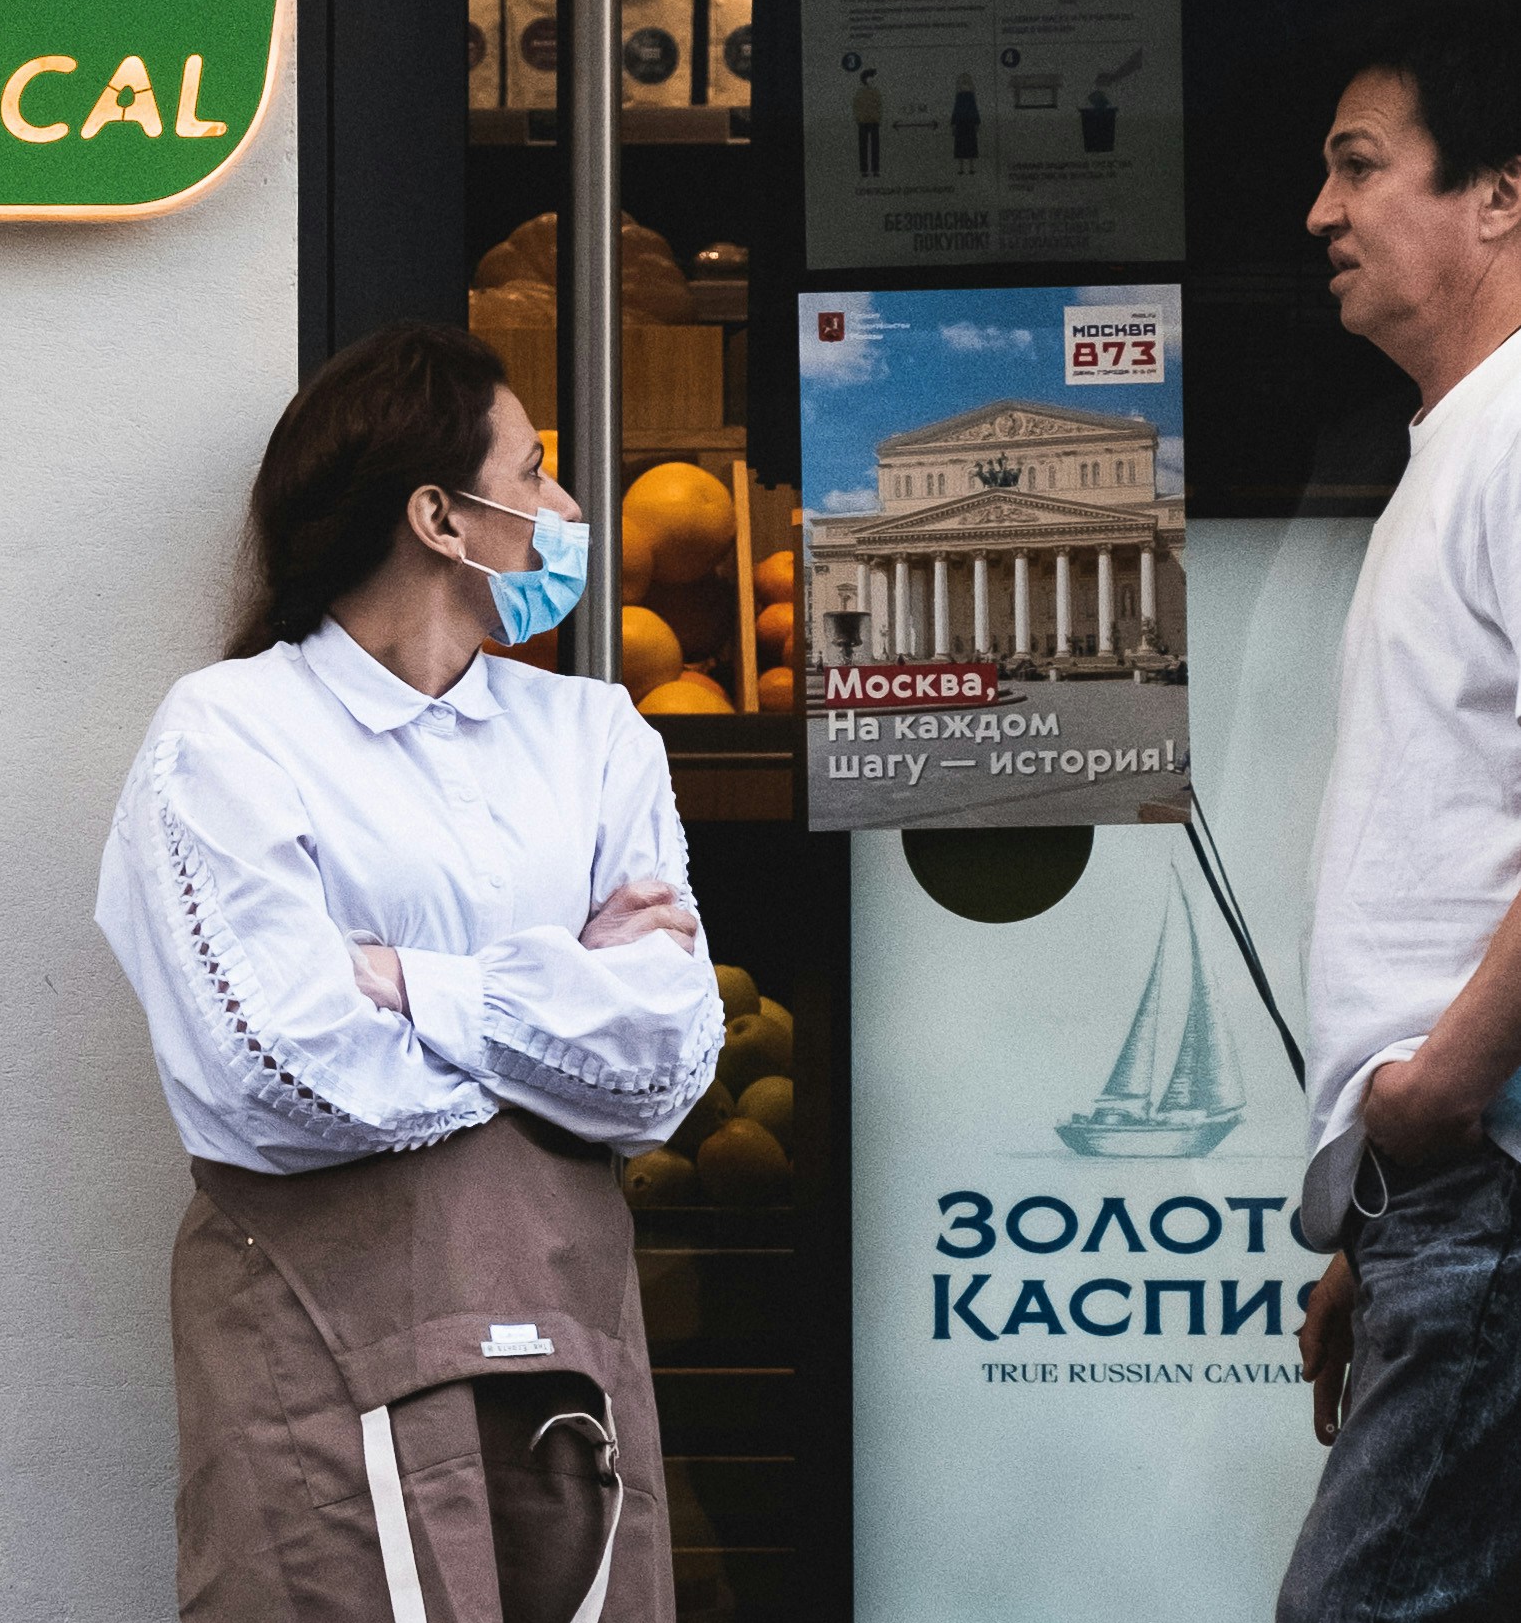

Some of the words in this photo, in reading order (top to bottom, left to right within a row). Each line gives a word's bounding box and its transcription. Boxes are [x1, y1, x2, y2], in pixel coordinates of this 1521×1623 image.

[1072, 323, 1156, 338] МОСКВА
[1073, 340, 1157, 367] 873
[828, 669, 996, 702] Москва,
[828, 710, 879, 742] На
[894, 708, 1061, 745] каждом
[828, 753, 928, 785] шагу
[990, 741, 1177, 781] история!
[982, 1362, 1058, 1384] TRUE
[1069, 1362, 1194, 1384] RUSSIAN
